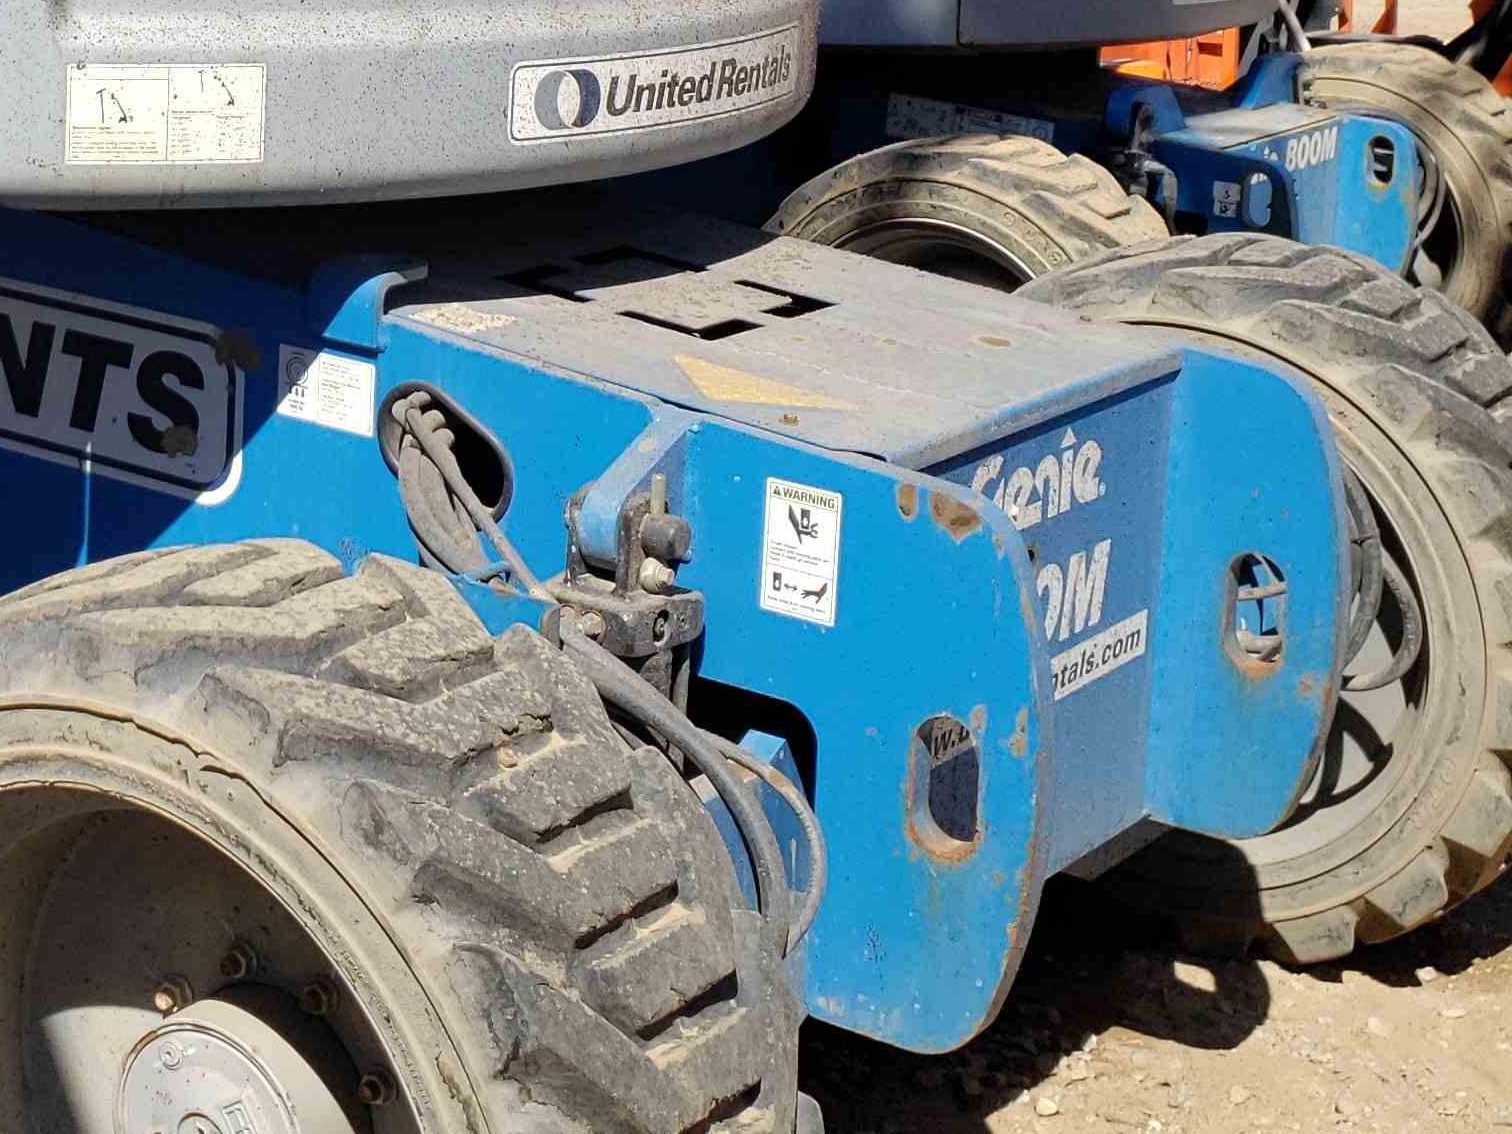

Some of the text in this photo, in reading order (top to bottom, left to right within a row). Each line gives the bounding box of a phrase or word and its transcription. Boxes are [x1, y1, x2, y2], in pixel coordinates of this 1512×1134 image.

[606, 44, 791, 116] United Rentals
[1286, 126, 1338, 171] BOOM
[782, 487, 836, 510] WARNING
